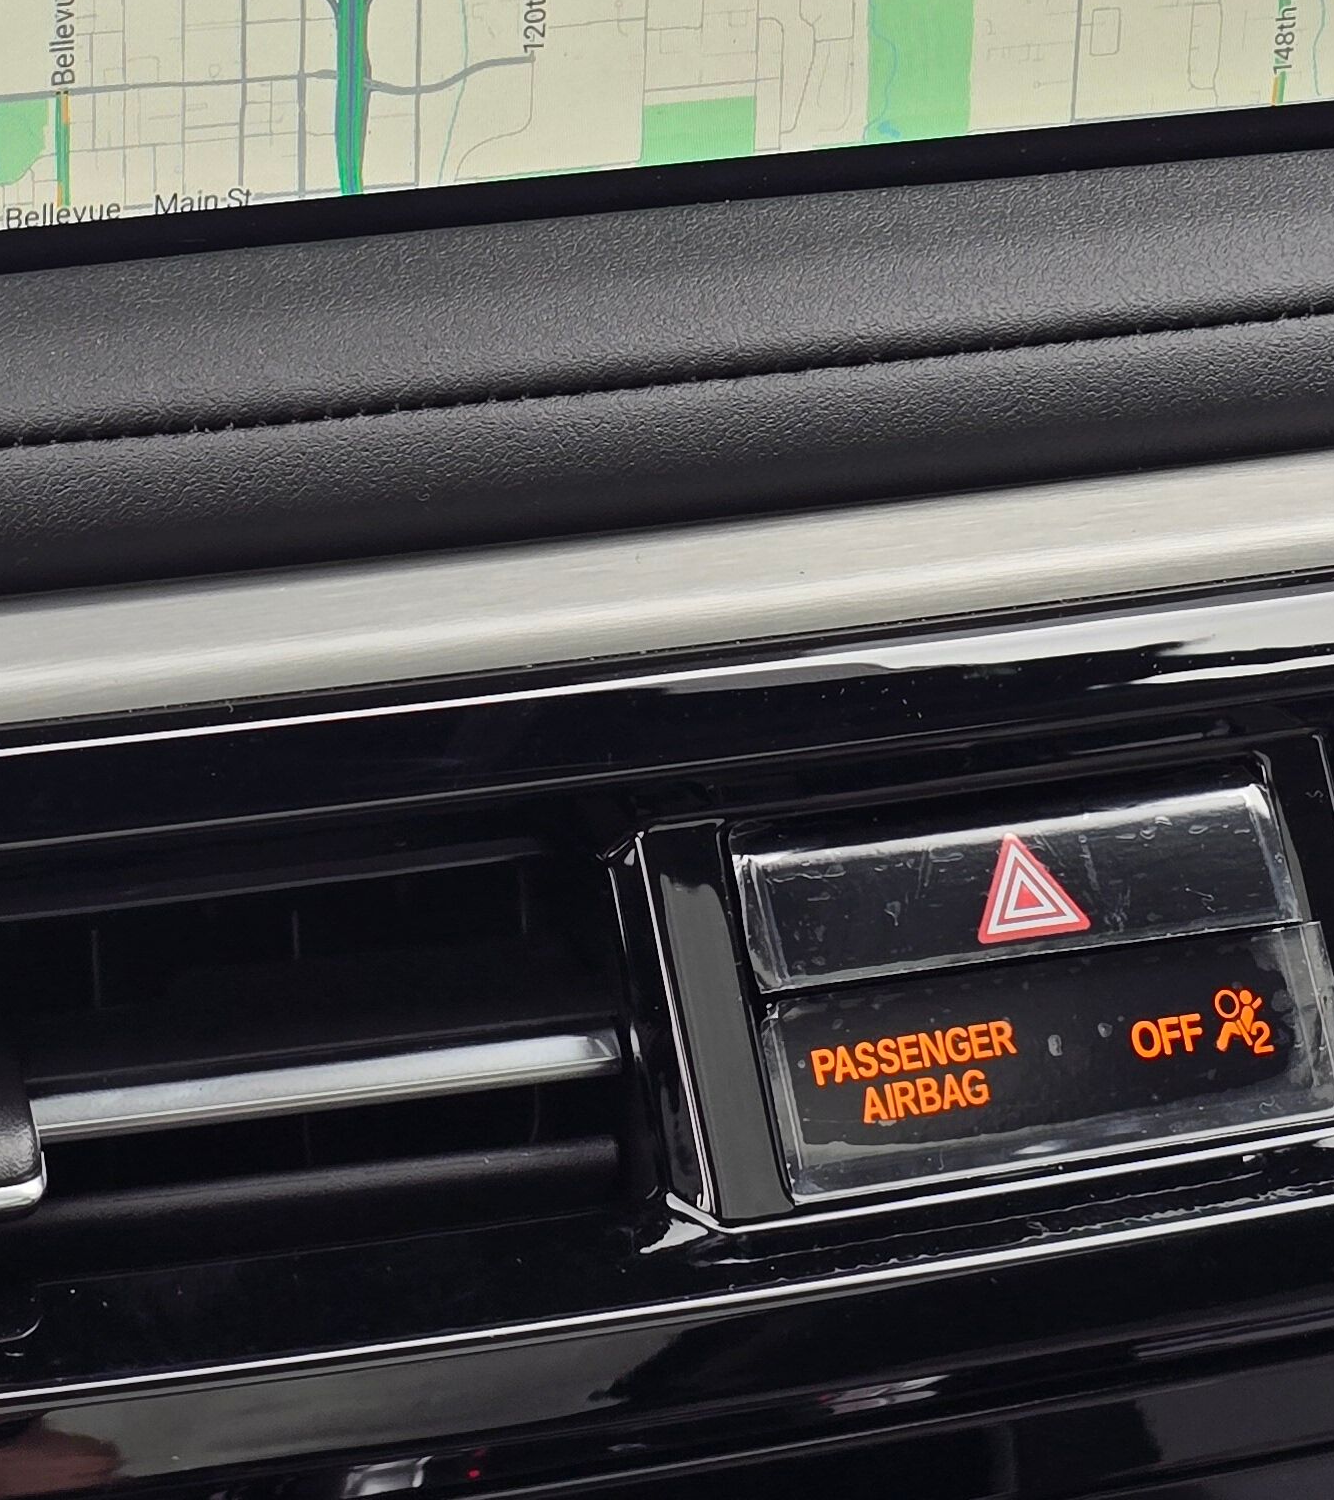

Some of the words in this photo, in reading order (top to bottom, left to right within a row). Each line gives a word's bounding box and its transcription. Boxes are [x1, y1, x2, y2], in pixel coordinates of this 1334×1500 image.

[1273, 6, 1297, 74] 148th
[6, 202, 121, 230] Bellevue
[155, 190, 218, 216] Main
[227, 188, 252, 208] St
[810, 1020, 1017, 1086] PASSENGER
[1131, 1012, 1203, 1060] OFF
[862, 1069, 991, 1124] AIRBAG
